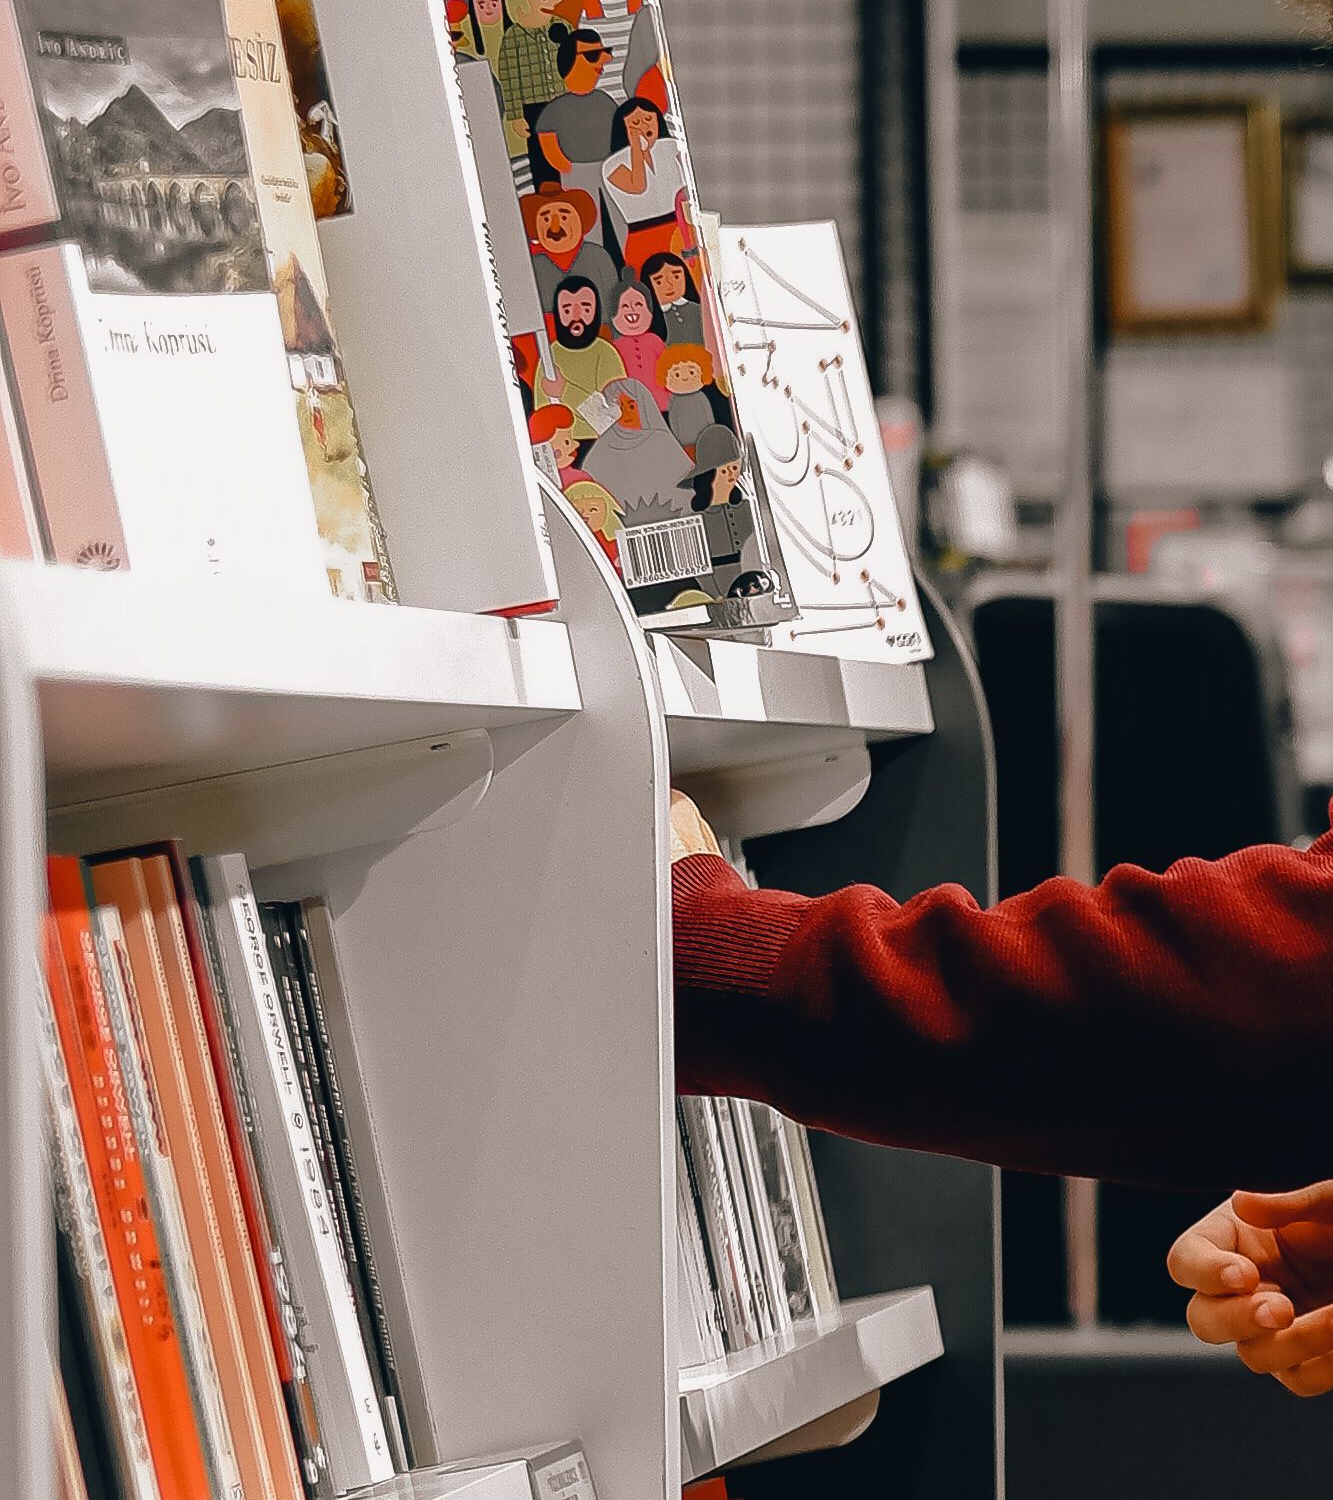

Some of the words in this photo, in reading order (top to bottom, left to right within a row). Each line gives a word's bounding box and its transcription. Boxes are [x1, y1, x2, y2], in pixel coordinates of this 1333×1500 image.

[24, 264, 60, 344] Köprüsü
[40, 348, 69, 403] Drina
[78, 929, 113, 1043] GEORGE
[102, 1046, 138, 1163] ORWELL
[235, 882, 269, 986] GEORGE
[261, 991, 295, 1095] ORWELL
[299, 1145, 330, 1237] 1984
